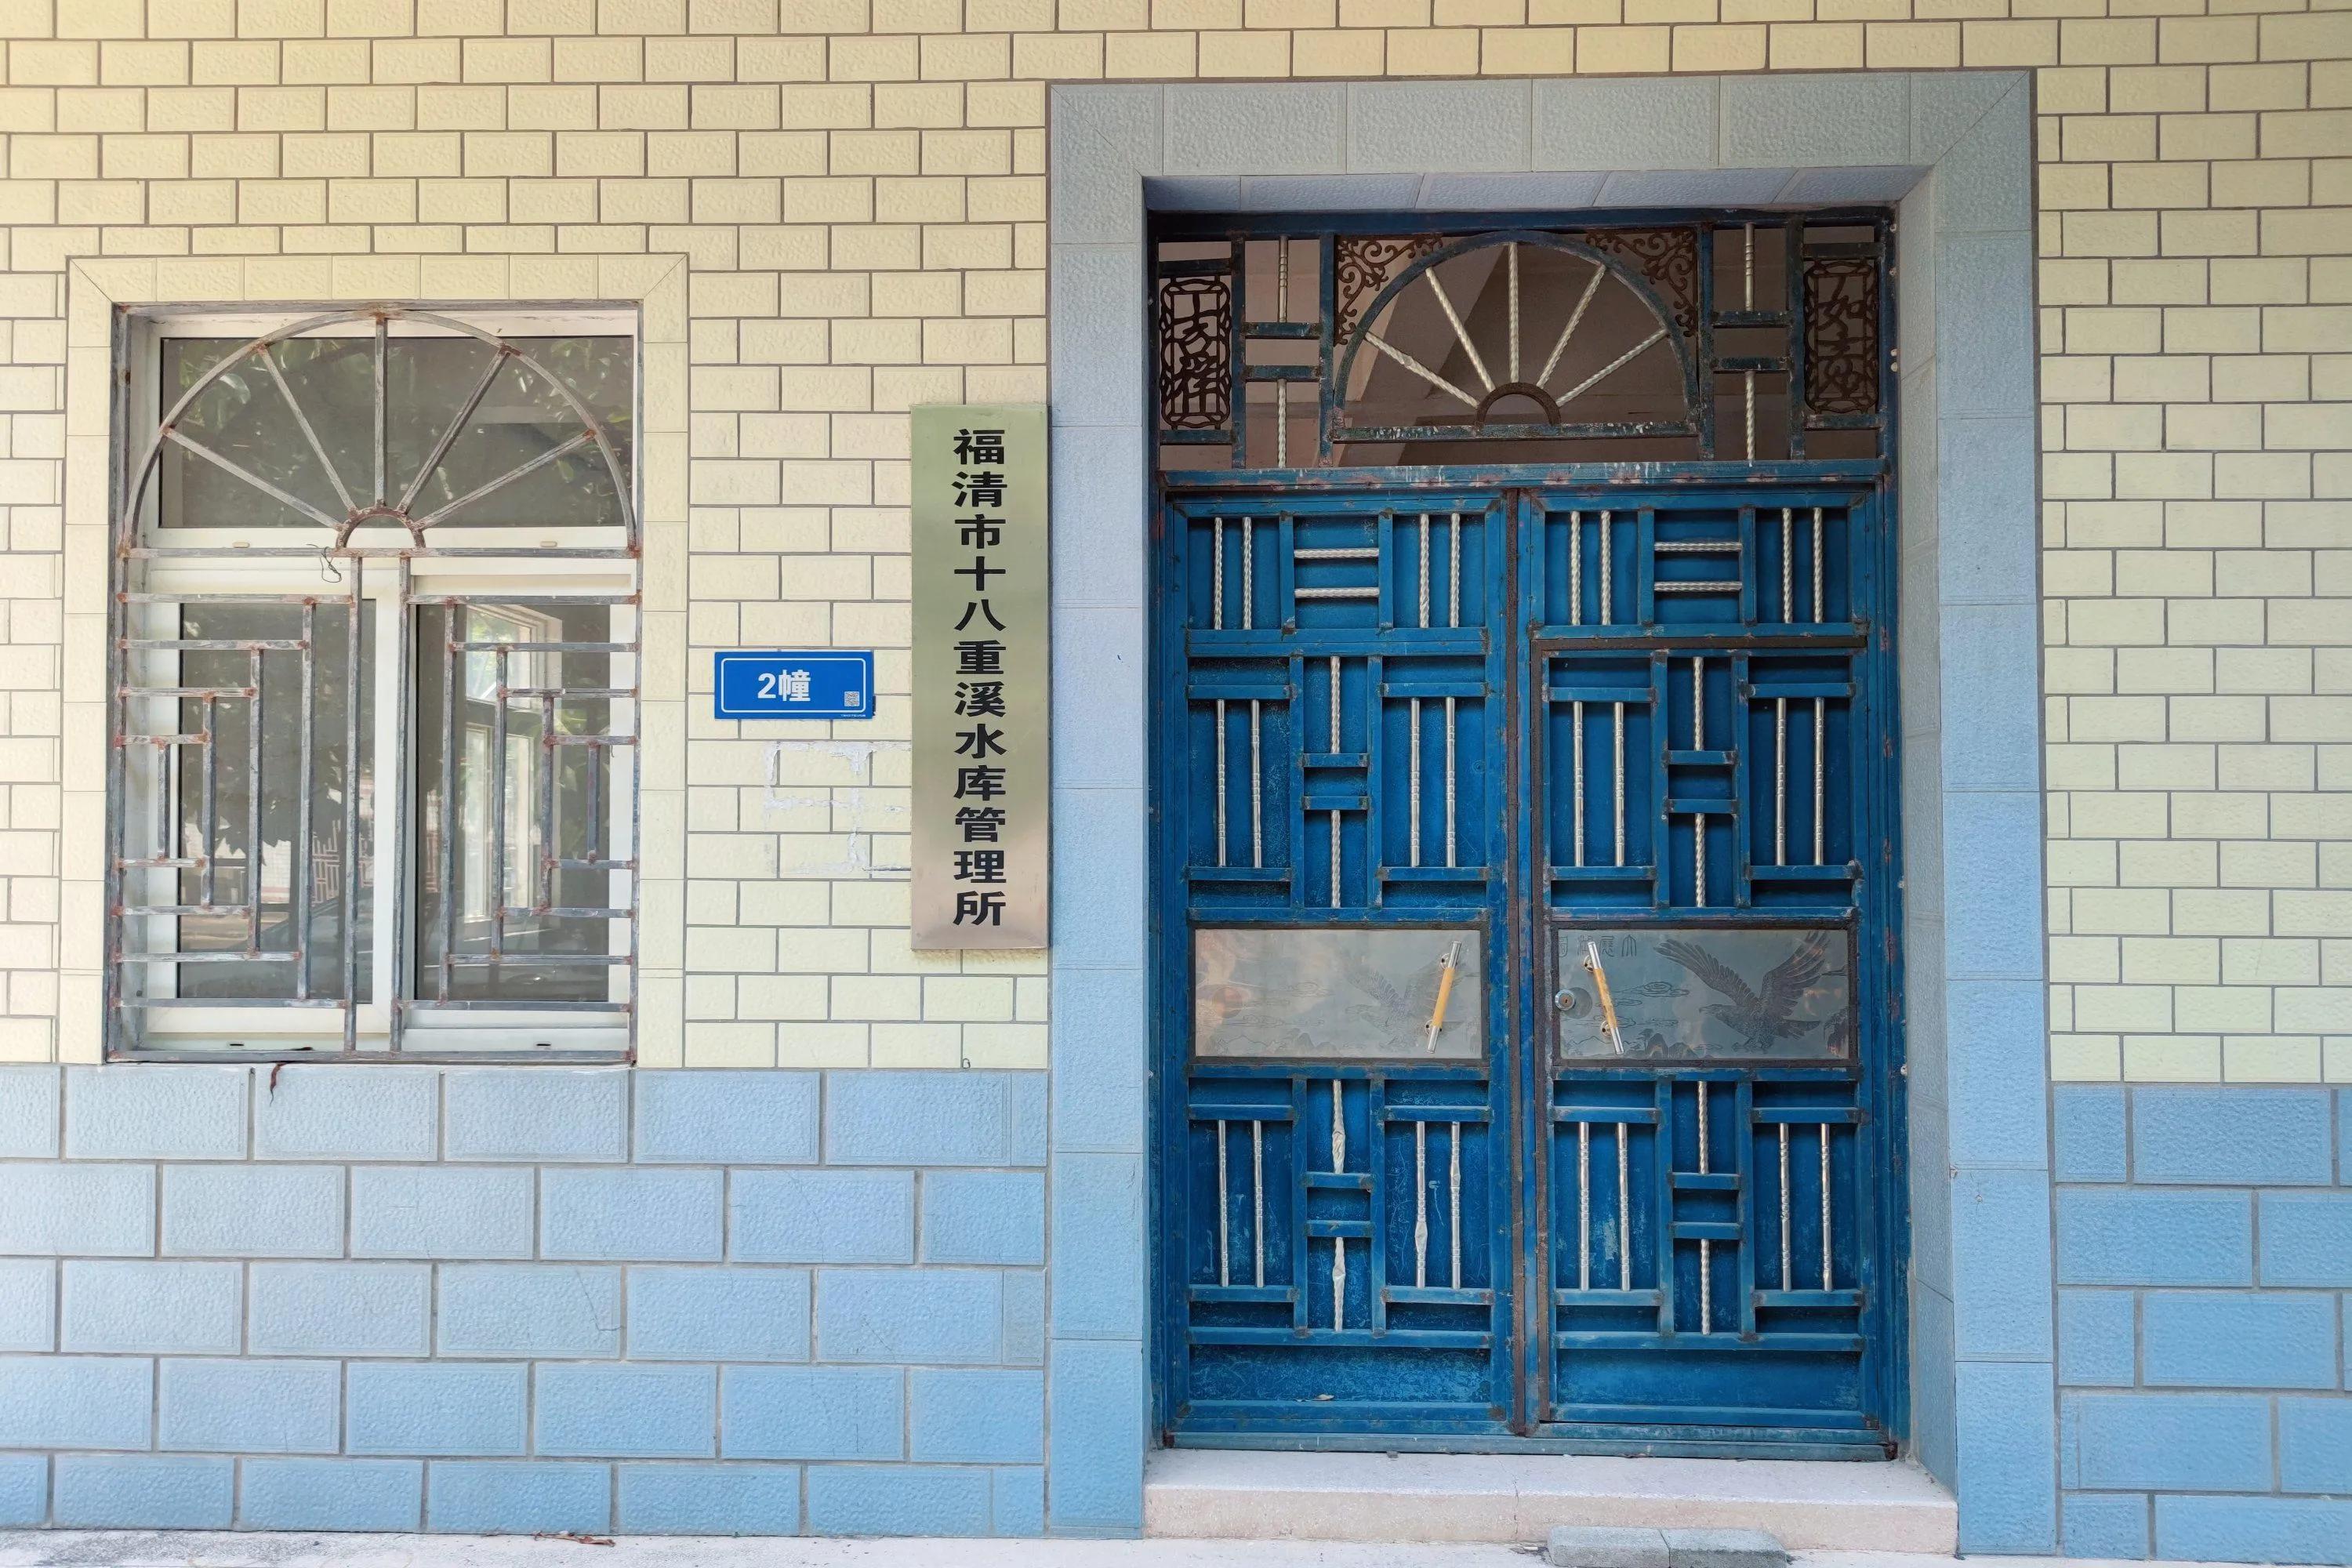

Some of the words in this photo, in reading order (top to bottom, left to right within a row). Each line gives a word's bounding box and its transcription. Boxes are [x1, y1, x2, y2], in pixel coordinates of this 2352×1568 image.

[757, 670, 811, 702] 2幢
[951, 428, 1008, 926] 福清市十八重溪水库管理所
